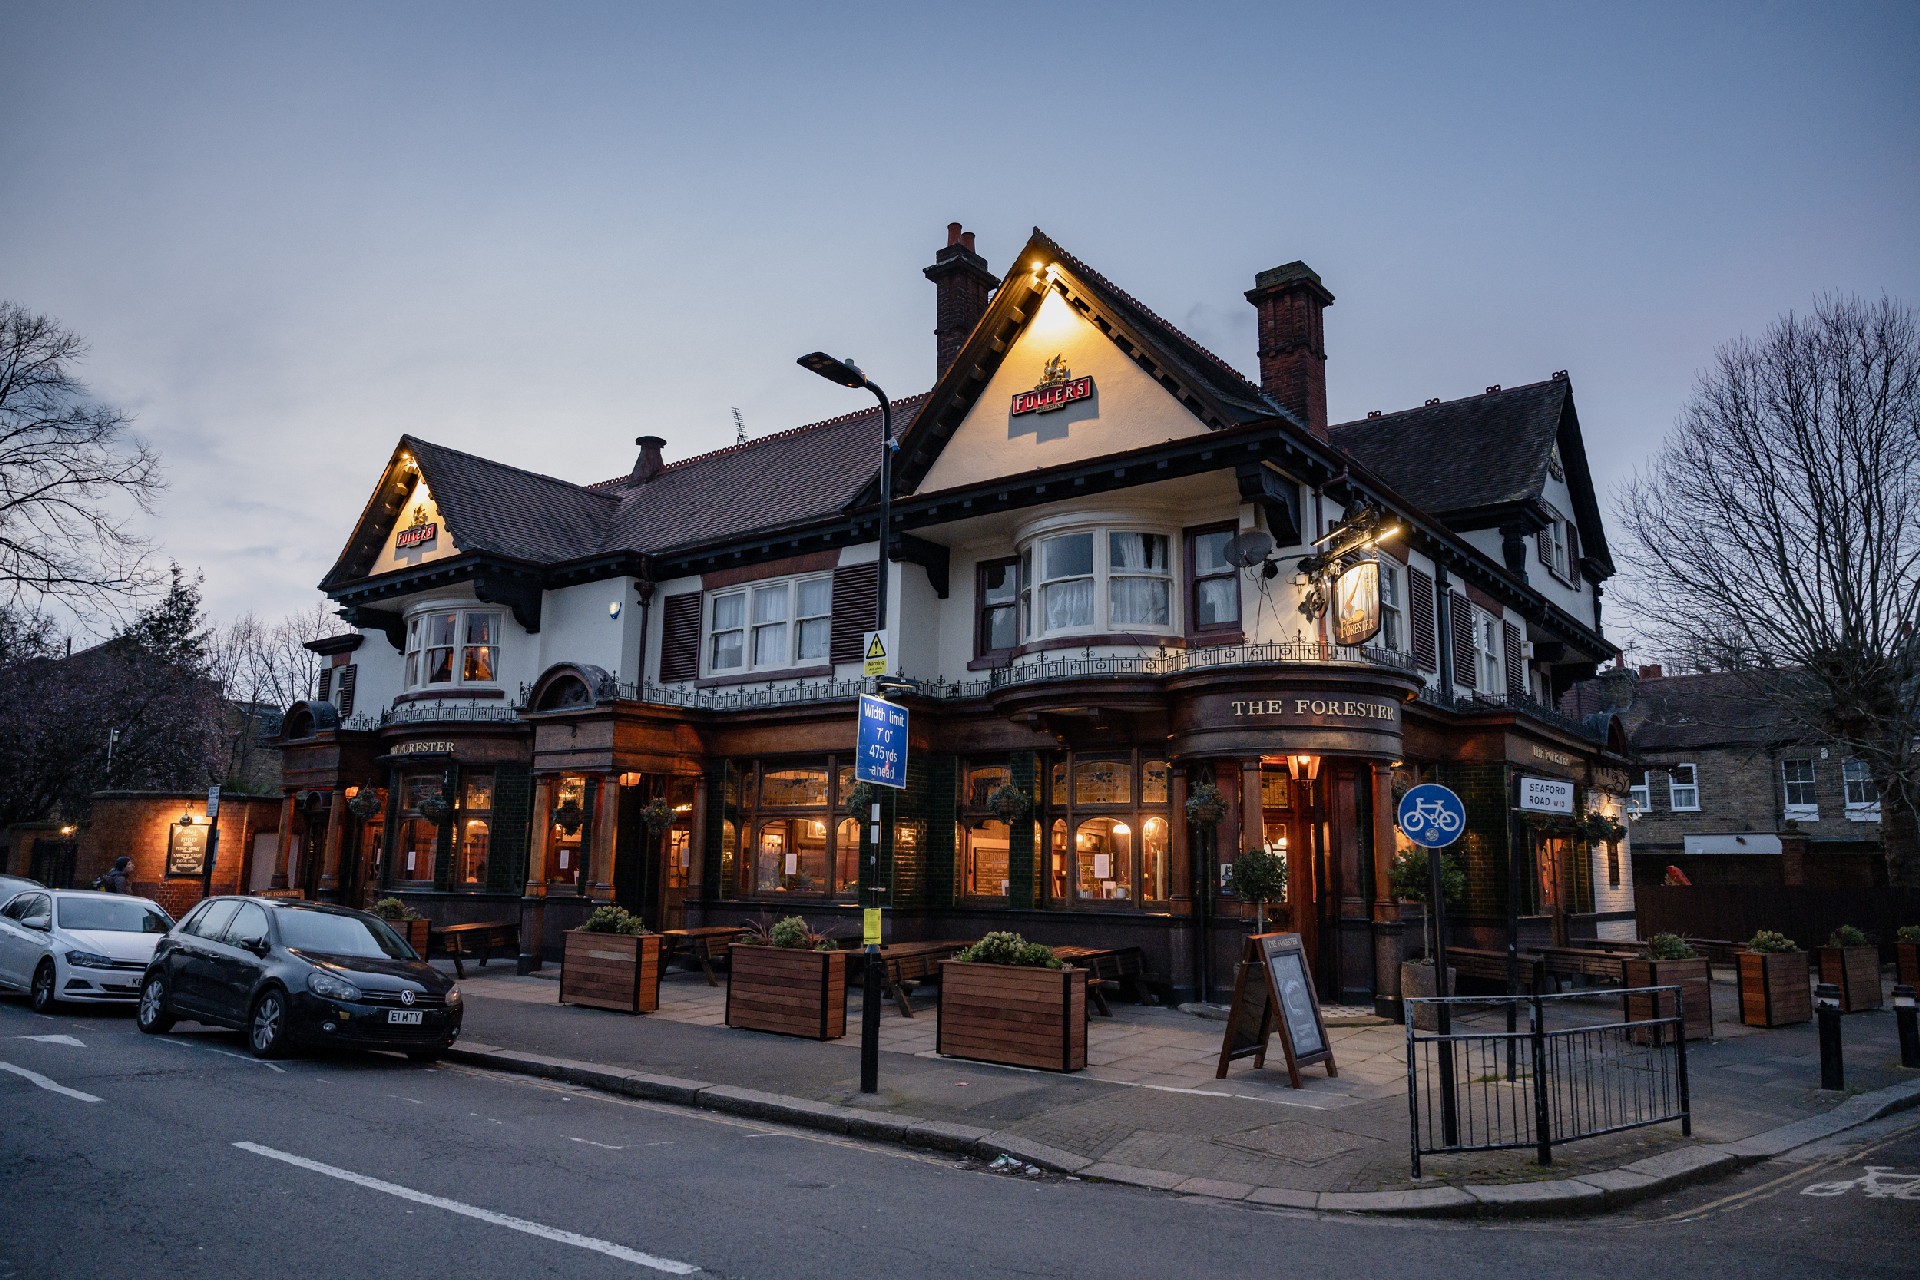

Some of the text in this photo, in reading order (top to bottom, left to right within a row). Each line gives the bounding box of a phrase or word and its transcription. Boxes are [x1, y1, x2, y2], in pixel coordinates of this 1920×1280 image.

[1016, 382, 1084, 410] FULLER'S
[397, 526, 433, 544] FULLER'S
[1340, 618, 1374, 639] FORESTER
[864, 702, 905, 727] Width limit
[1231, 699, 1395, 721] THE FORESTER
[869, 744, 898, 763] 475 yds
[870, 763, 895, 780] ahead
[1529, 783, 1566, 795] SEAFORD
[1529, 795, 1551, 805] ROAD
